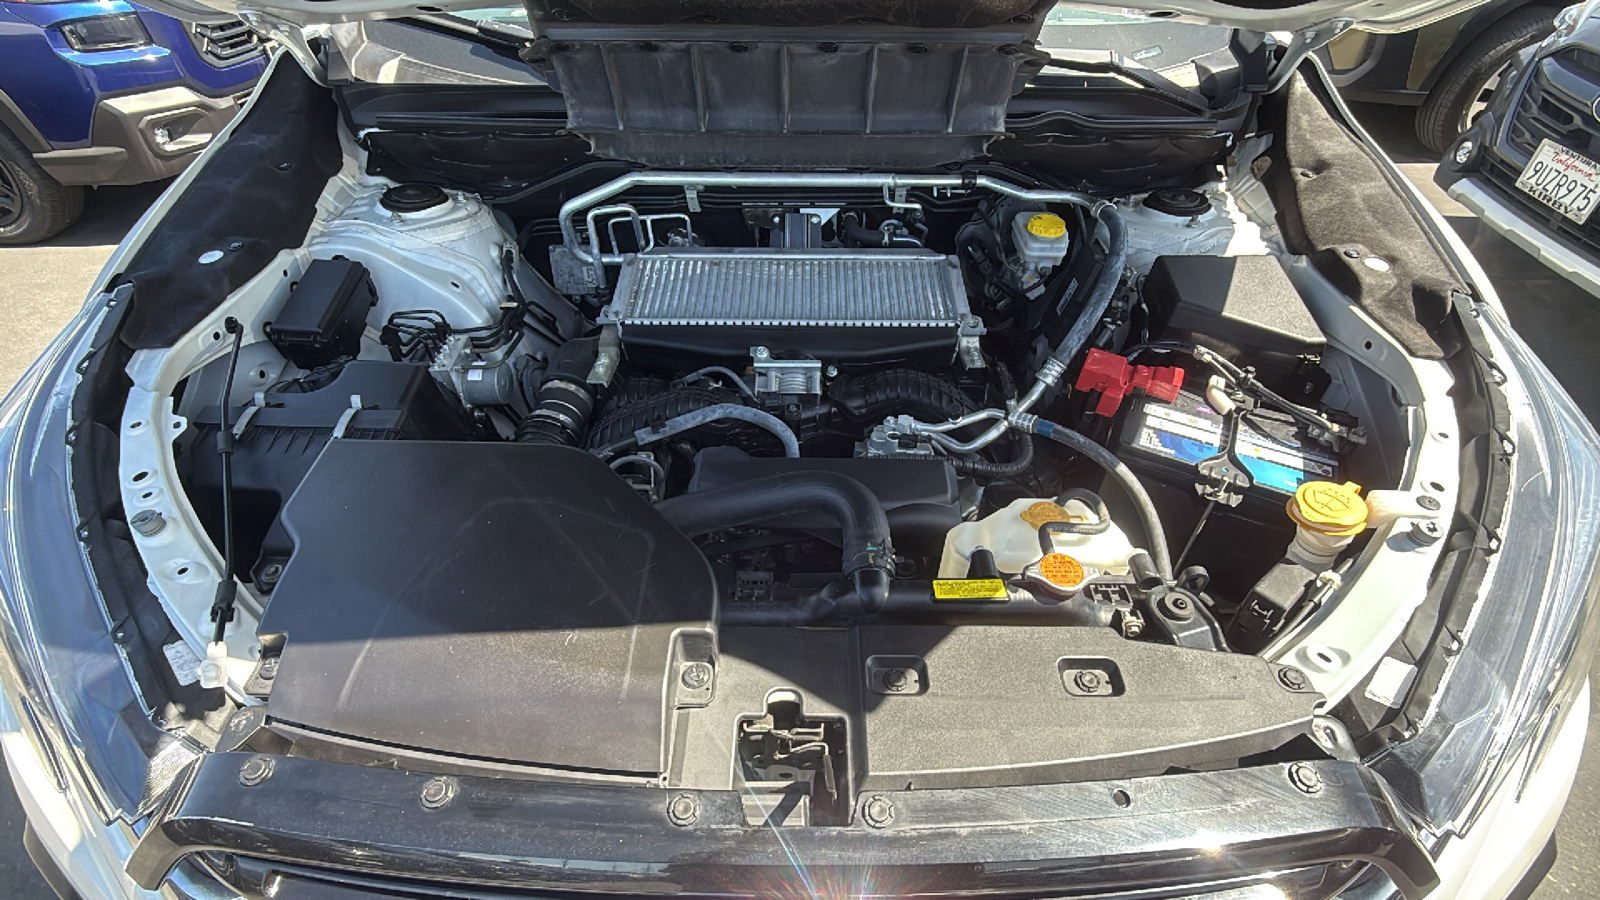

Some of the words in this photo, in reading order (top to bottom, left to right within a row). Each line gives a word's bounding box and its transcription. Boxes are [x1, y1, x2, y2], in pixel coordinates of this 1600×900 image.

[1552, 151, 1595, 182] California
[1561, 147, 1598, 170] VENTURA
[1526, 161, 1597, 212] 9UZR975
[1528, 186, 1573, 215] KIRBY
